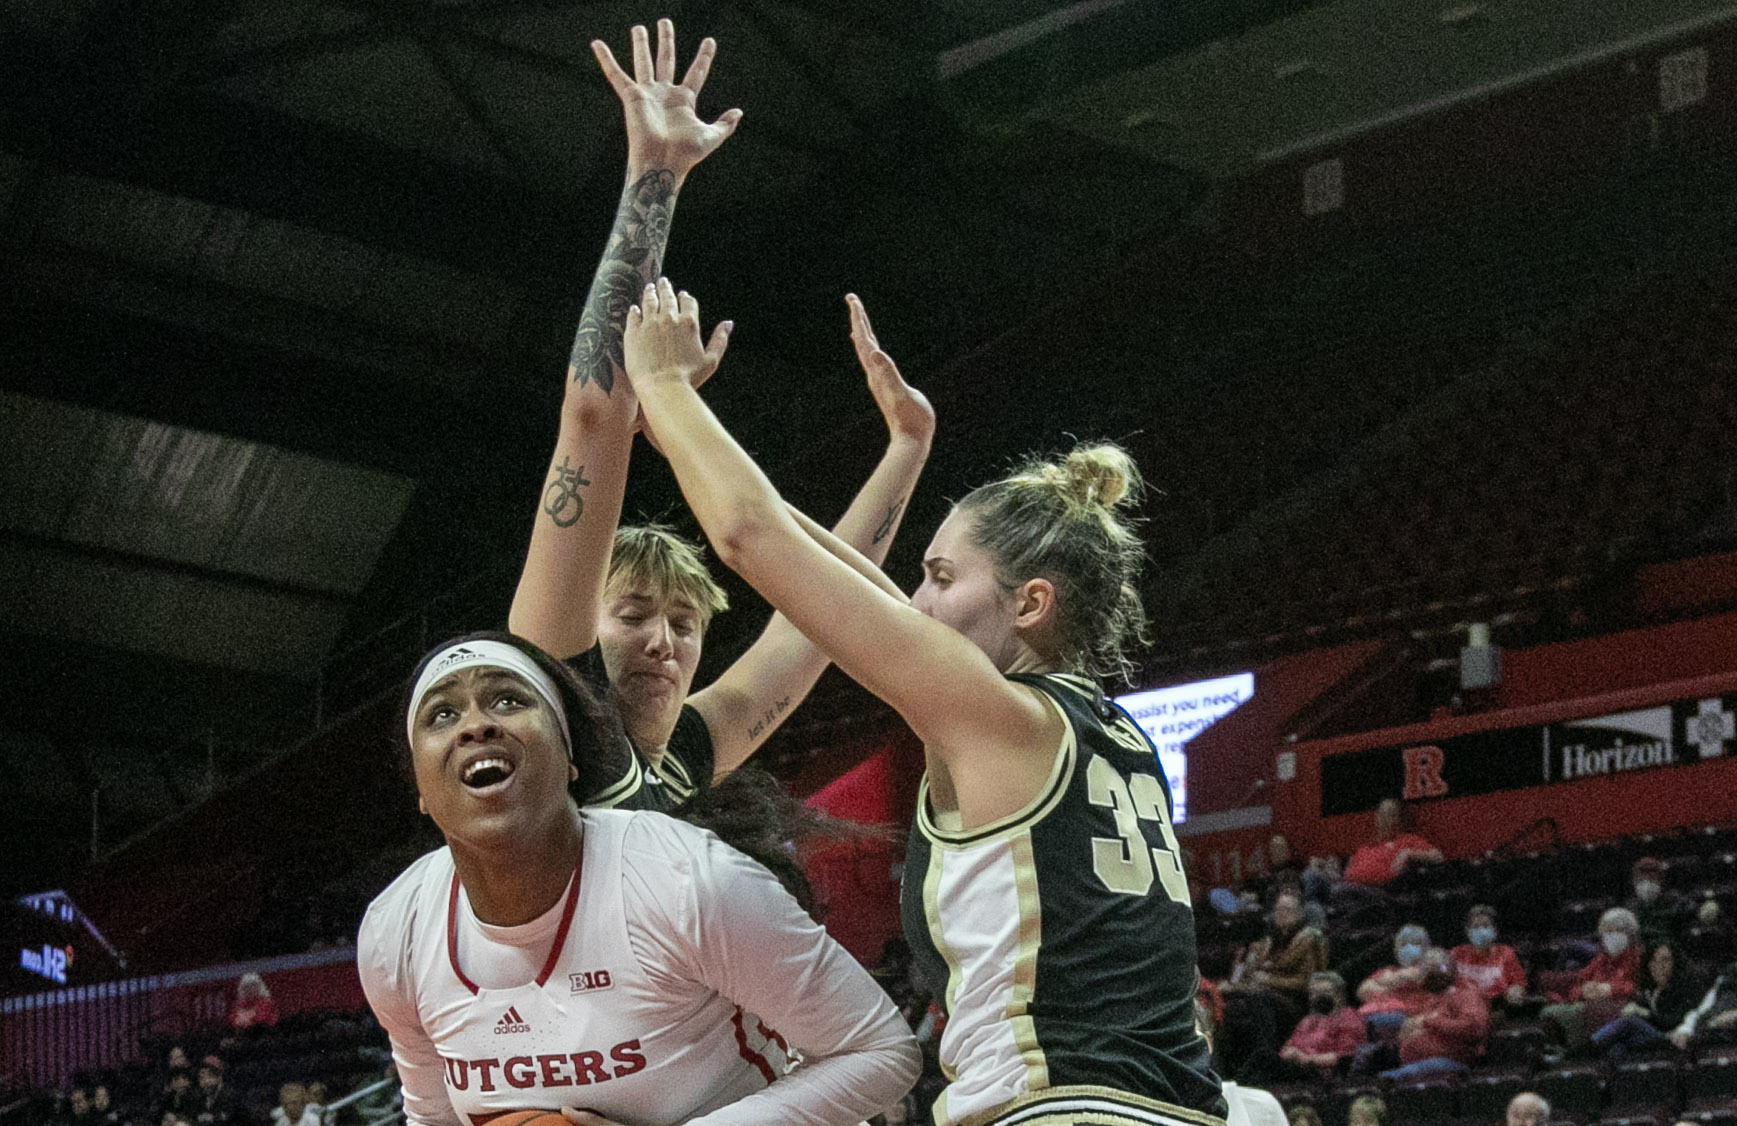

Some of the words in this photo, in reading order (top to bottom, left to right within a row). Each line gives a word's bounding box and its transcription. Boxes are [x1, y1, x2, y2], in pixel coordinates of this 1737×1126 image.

[1173, 699, 1198, 716] you
[1202, 688, 1240, 706] need
[1562, 737, 1673, 779] Horizon
[1086, 753, 1191, 908] 33
[494, 1023, 531, 1035] adidas
[444, 1039, 647, 1092] UTGERS
